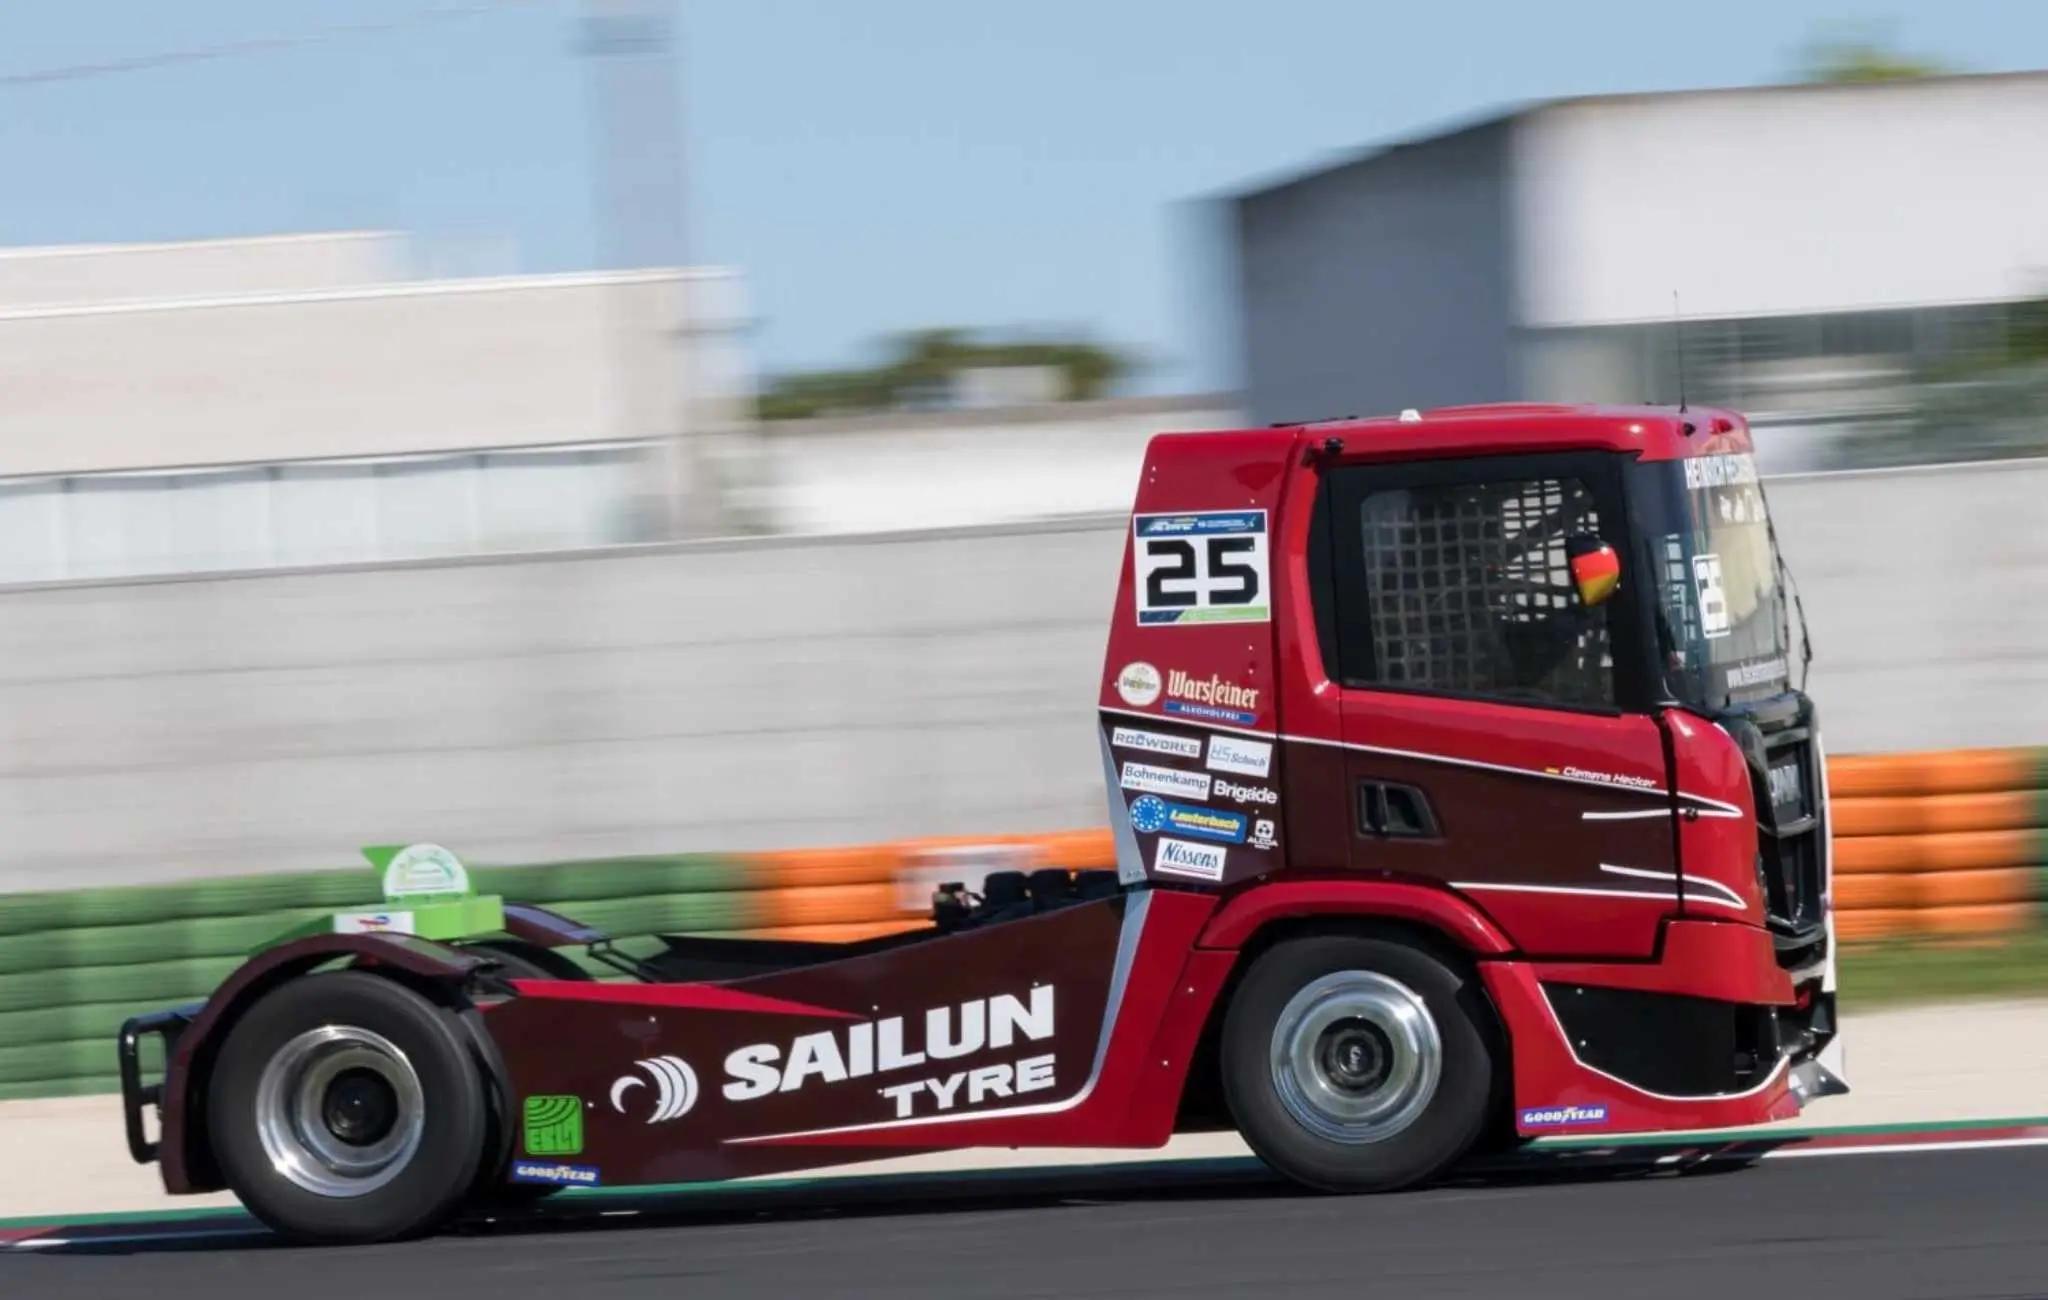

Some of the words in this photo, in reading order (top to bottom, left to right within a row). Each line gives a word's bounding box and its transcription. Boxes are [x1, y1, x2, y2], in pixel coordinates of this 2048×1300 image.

[1147, 537, 1258, 607] 25
[1168, 669, 1259, 709] Warsteiner
[1125, 765, 1208, 789] Bohnenkamp
[1214, 779, 1278, 804] Brigade
[1161, 842, 1219, 868] Nissens
[723, 984, 1054, 1101] SAILUN
[884, 1054, 1056, 1118] TYRE
[1524, 1106, 1605, 1124] GOODYEAR
[517, 1166, 597, 1181] GOODYEAR
